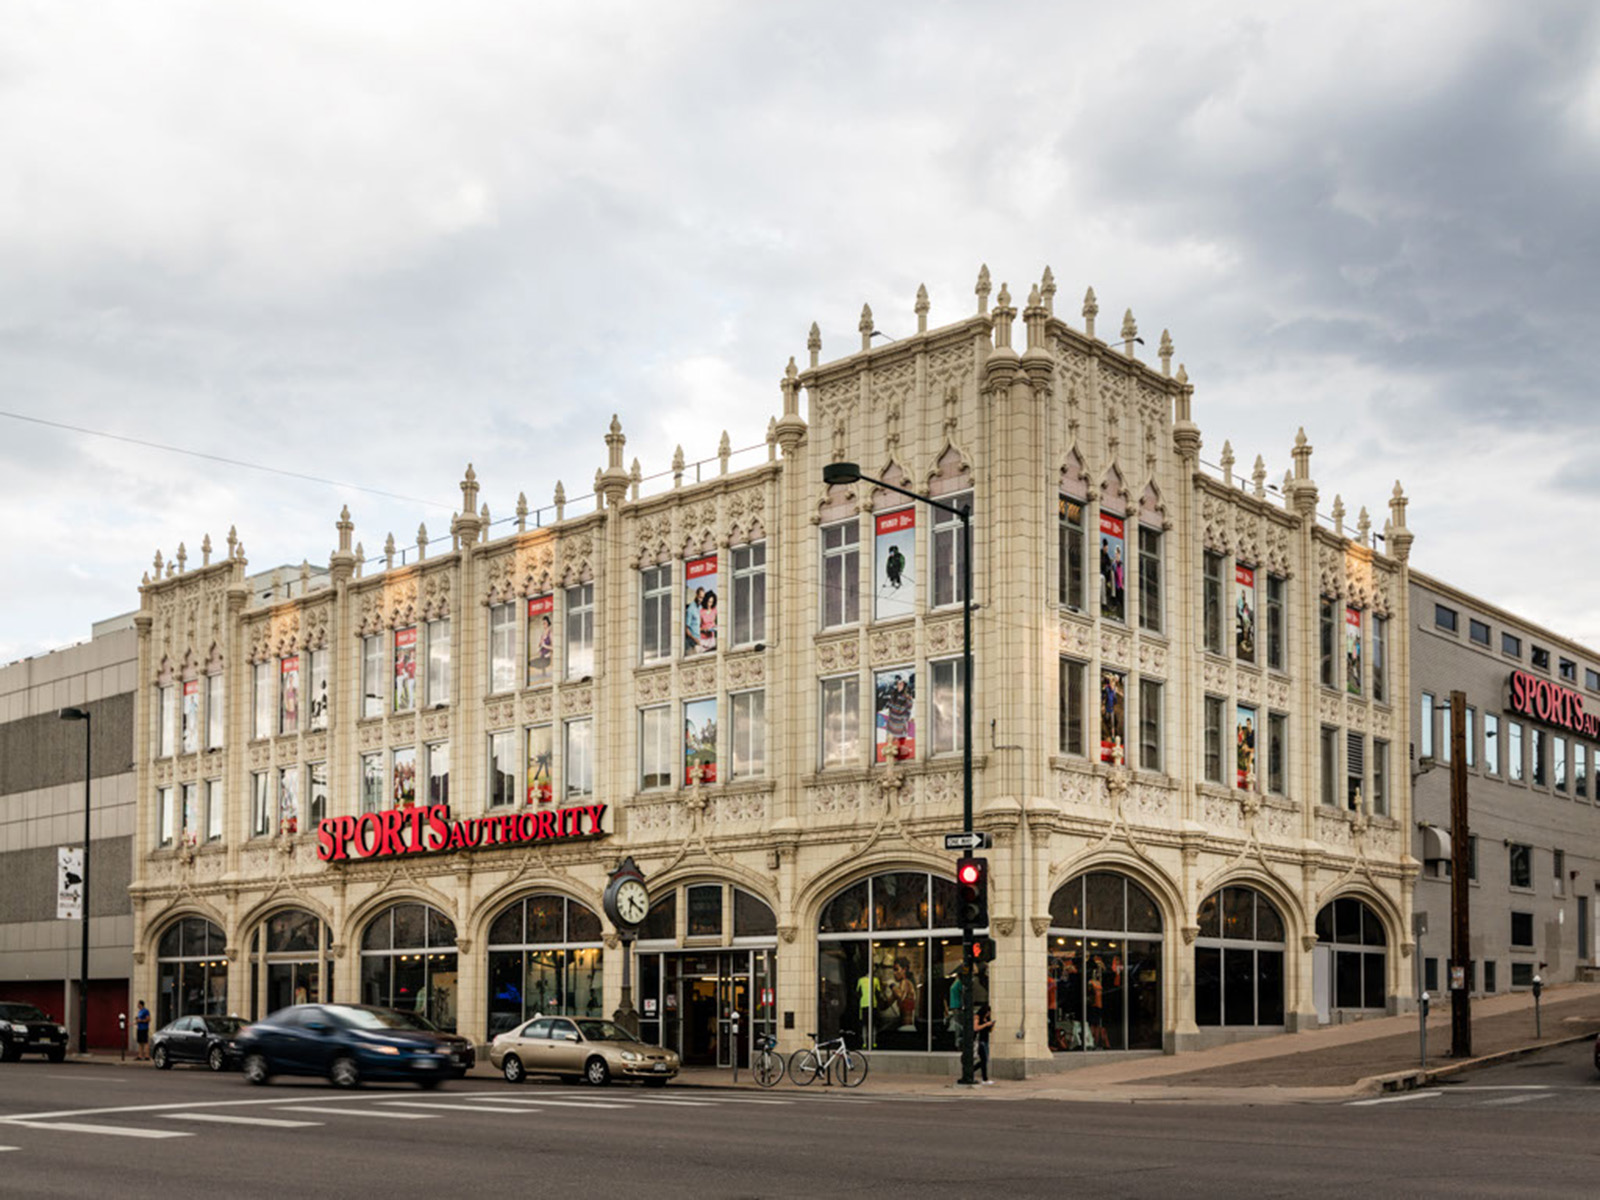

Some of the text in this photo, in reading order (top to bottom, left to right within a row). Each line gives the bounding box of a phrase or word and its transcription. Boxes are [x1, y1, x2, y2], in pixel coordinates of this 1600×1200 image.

[1511, 670, 1584, 732] SPORTS
[316, 804, 608, 861] SPORTS AUTHORITY
